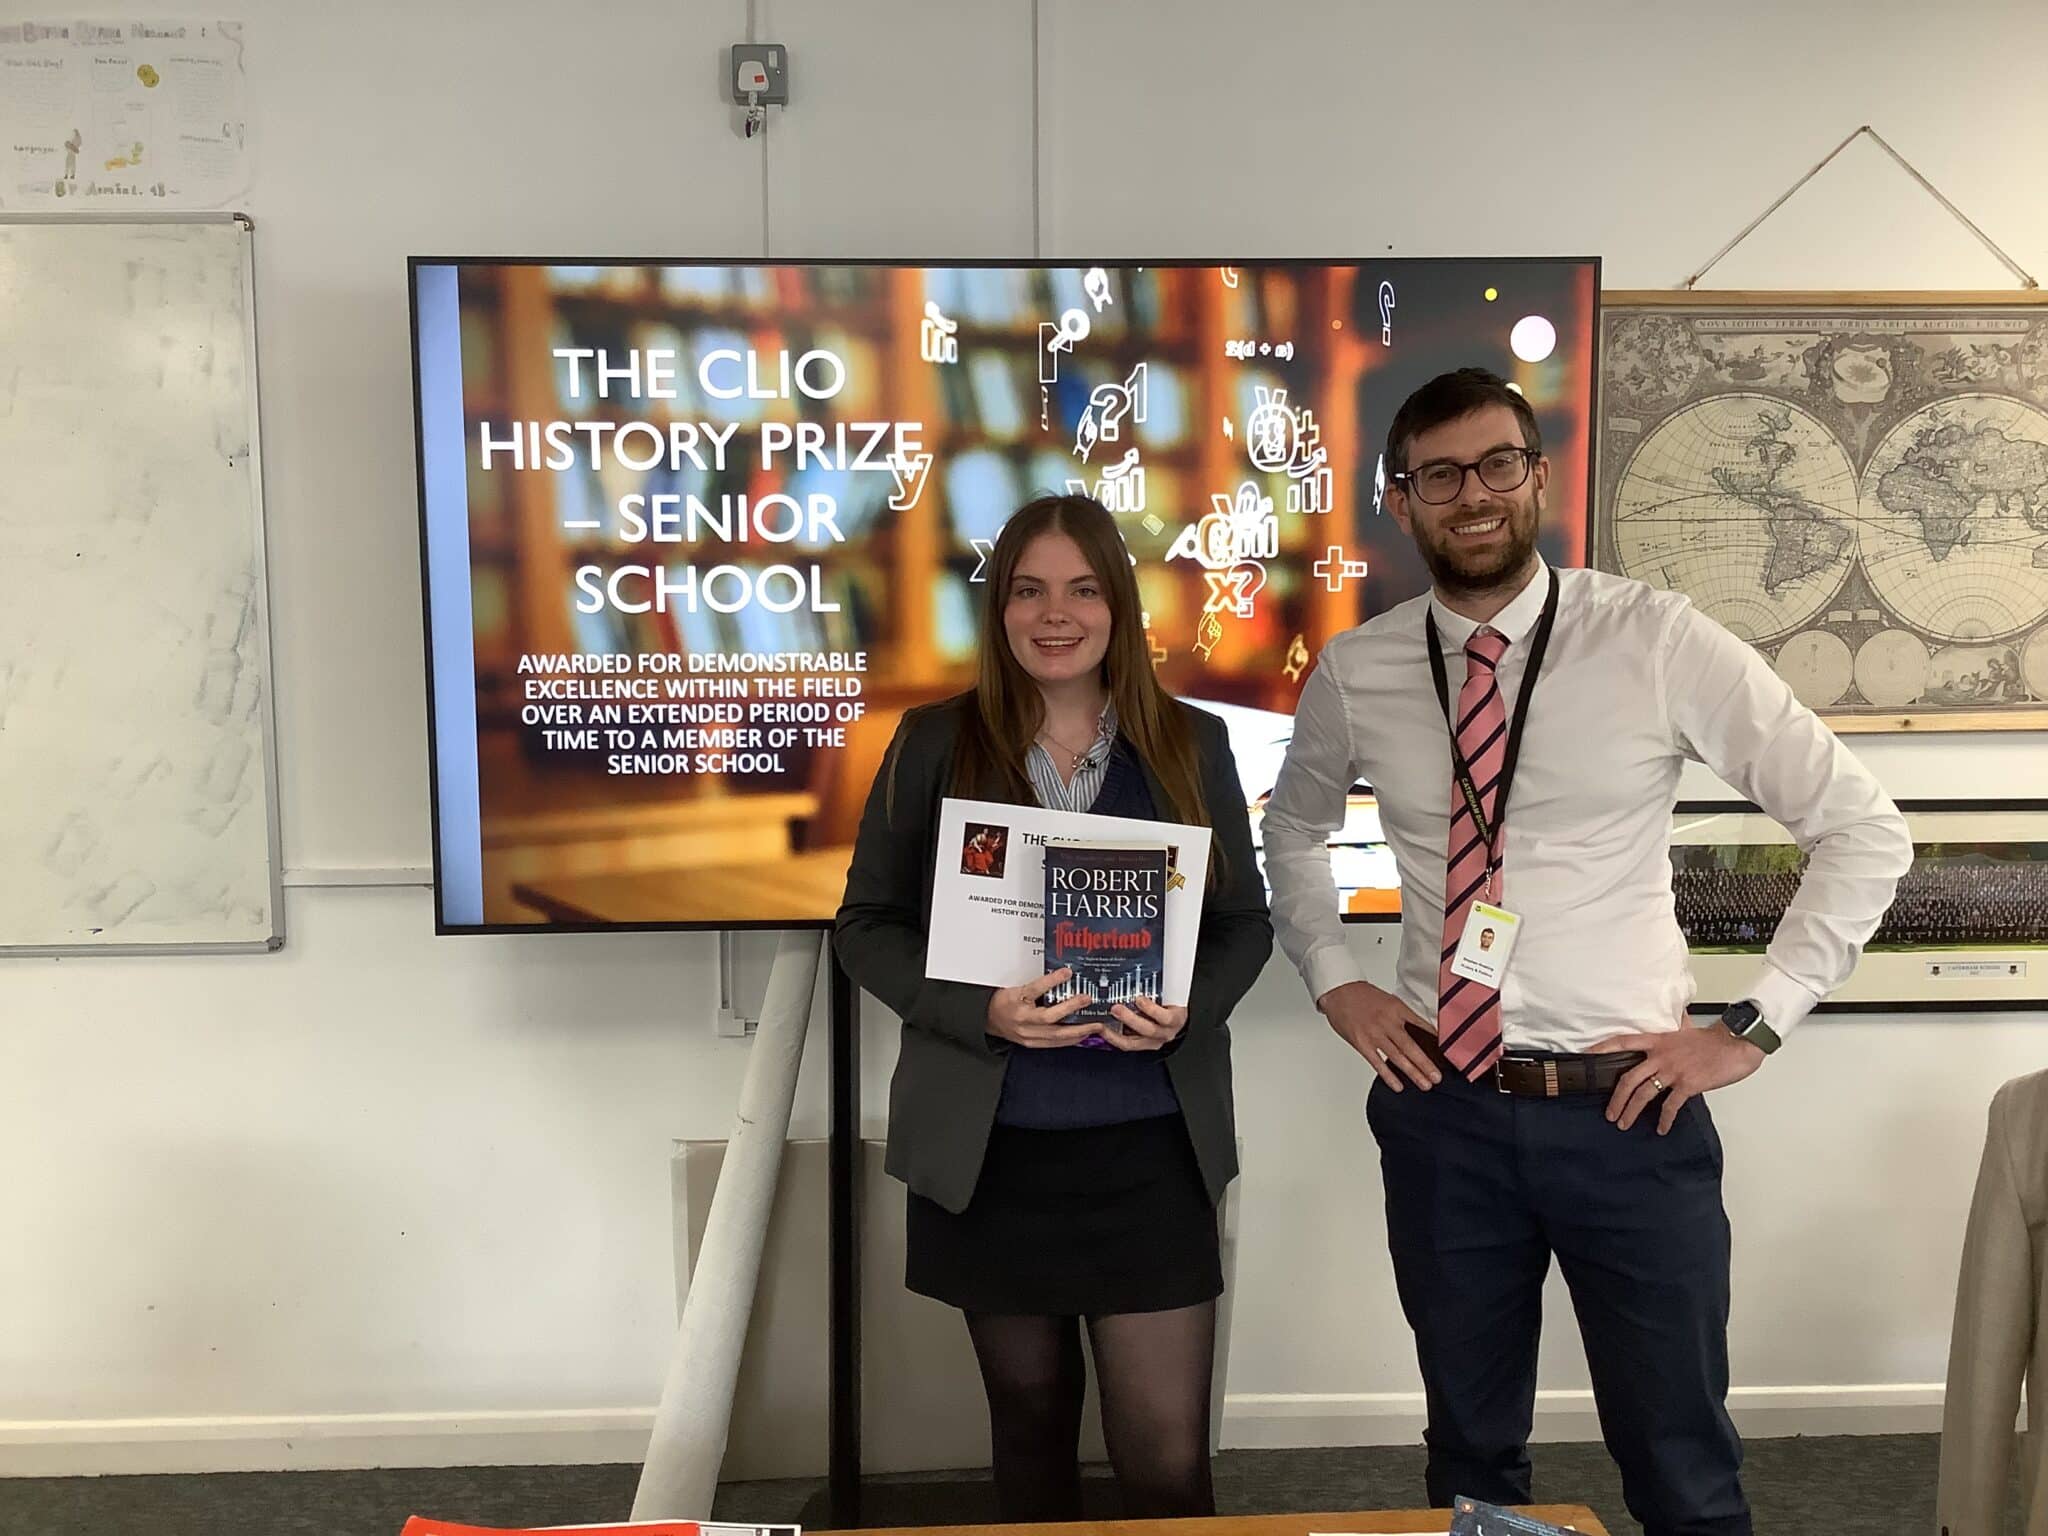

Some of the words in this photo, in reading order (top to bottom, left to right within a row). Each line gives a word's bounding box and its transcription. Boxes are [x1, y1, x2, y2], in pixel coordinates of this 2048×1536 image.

[553, 348, 677, 399] THE
[699, 348, 846, 400] CLIO
[480, 421, 741, 471] HISTORY
[763, 422, 923, 471] PRIZE
[618, 493, 845, 544] SENIOR
[575, 564, 841, 614] SCHOOL
[517, 654, 631, 674] AWARDED
[638, 654, 681, 674] FOR
[688, 653, 867, 673] DEMONSTRABLE
[525, 679, 659, 700] EXCELLENCE
[664, 679, 748, 699] WITHIN
[753, 678, 798, 699] THE
[803, 678, 861, 698] FIELD
[521, 704, 583, 725] OVER
[588, 704, 622, 724] AN
[628, 703, 743, 724] EXTENDED
[750, 703, 830, 723] PERIOD
[834, 702, 865, 722] OF
[542, 730, 598, 750] TIME
[603, 729, 636, 750] TO
[641, 729, 658, 749] A
[663, 729, 761, 749] MEMBER
[767, 728, 798, 748] OF
[802, 727, 846, 748] THE
[607, 755, 689, 775] SENIOR
[694, 754, 785, 774] SCHOOL
[1022, 832, 1048, 847] THE
[1051, 867, 1159, 892] ROBERT
[968, 895, 1003, 905] AWARDED
[1018, 900, 1044, 909] DEMON
[991, 907, 1019, 917] HISTORY
[1020, 911, 1038, 919] OVER
[1051, 892, 1158, 919] HARRIS
[1053, 921, 1152, 959] Fatherland
